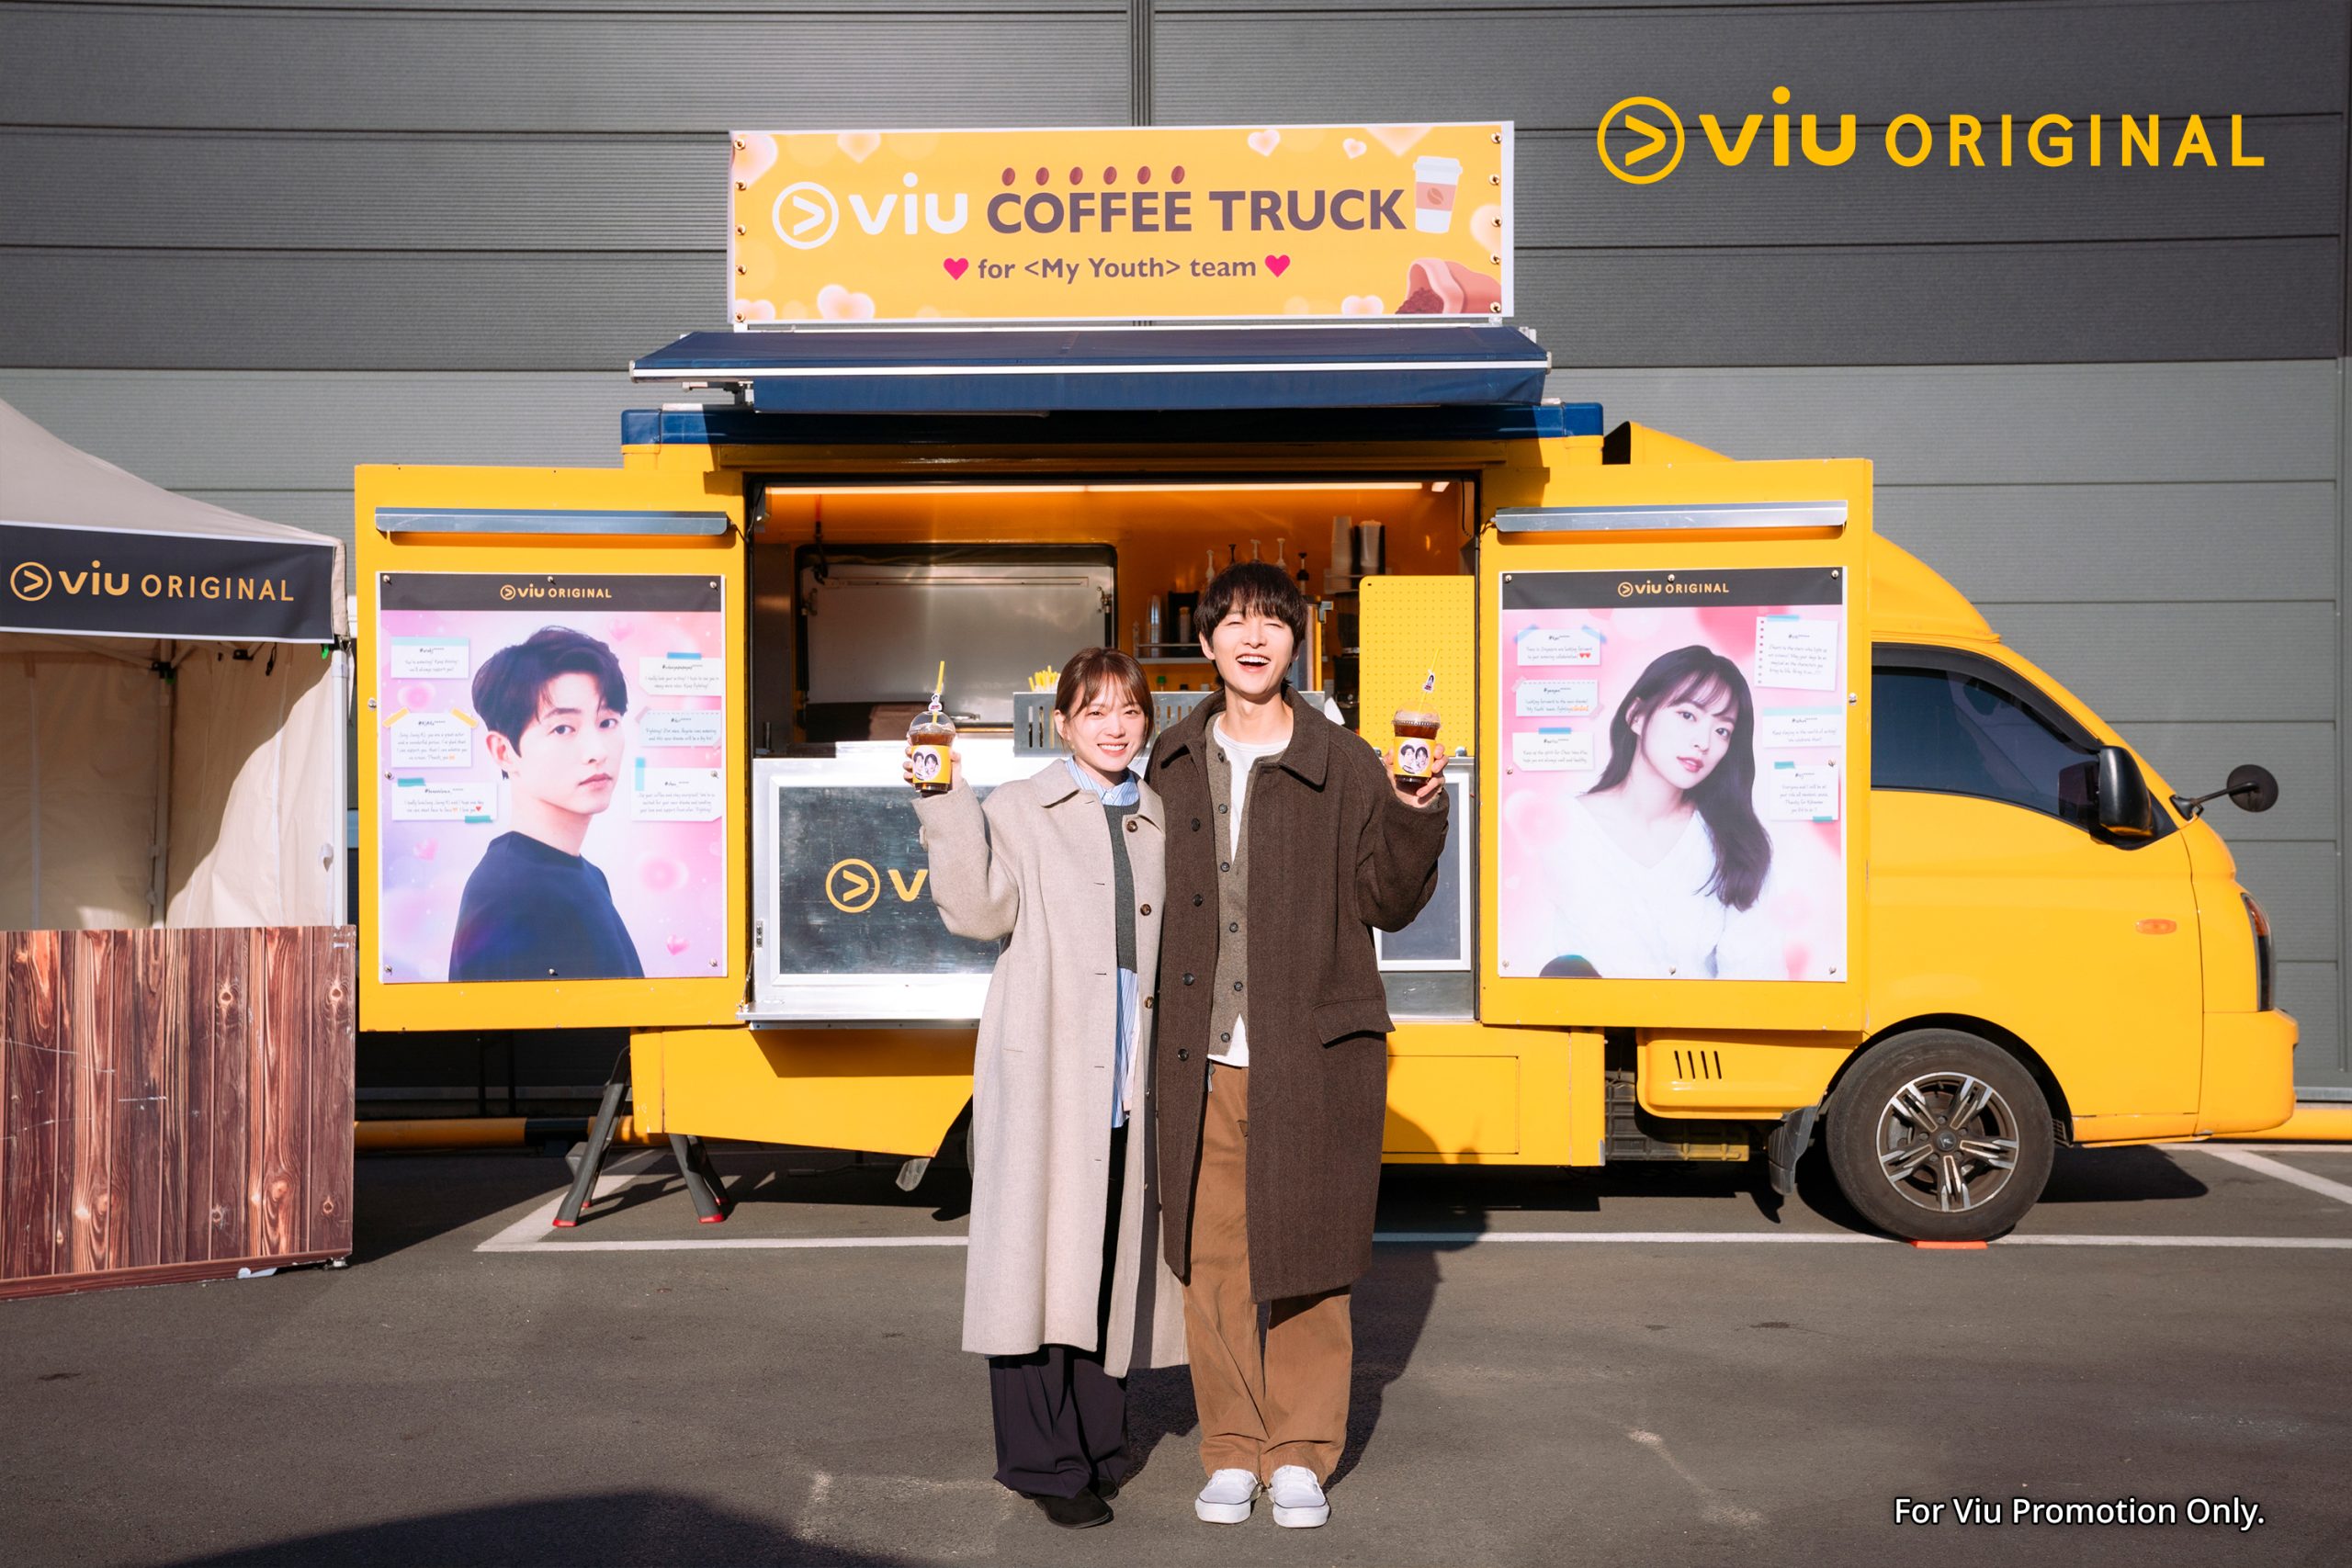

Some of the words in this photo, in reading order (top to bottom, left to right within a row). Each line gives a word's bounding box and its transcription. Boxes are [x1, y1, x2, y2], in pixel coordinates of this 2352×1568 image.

[987, 191, 1192, 234] COFFEE
[1208, 189, 1407, 231] TRUCK
[978, 259, 1015, 278] for
[1024, 258, 1080, 285] <My
[1089, 257, 1181, 277] Youth>
[1190, 260, 1256, 277] team
[141, 574, 294, 602] ORIGINAL
[548, 587, 613, 599] ORIGINAL
[1665, 583, 1730, 594] ORIGINAL
